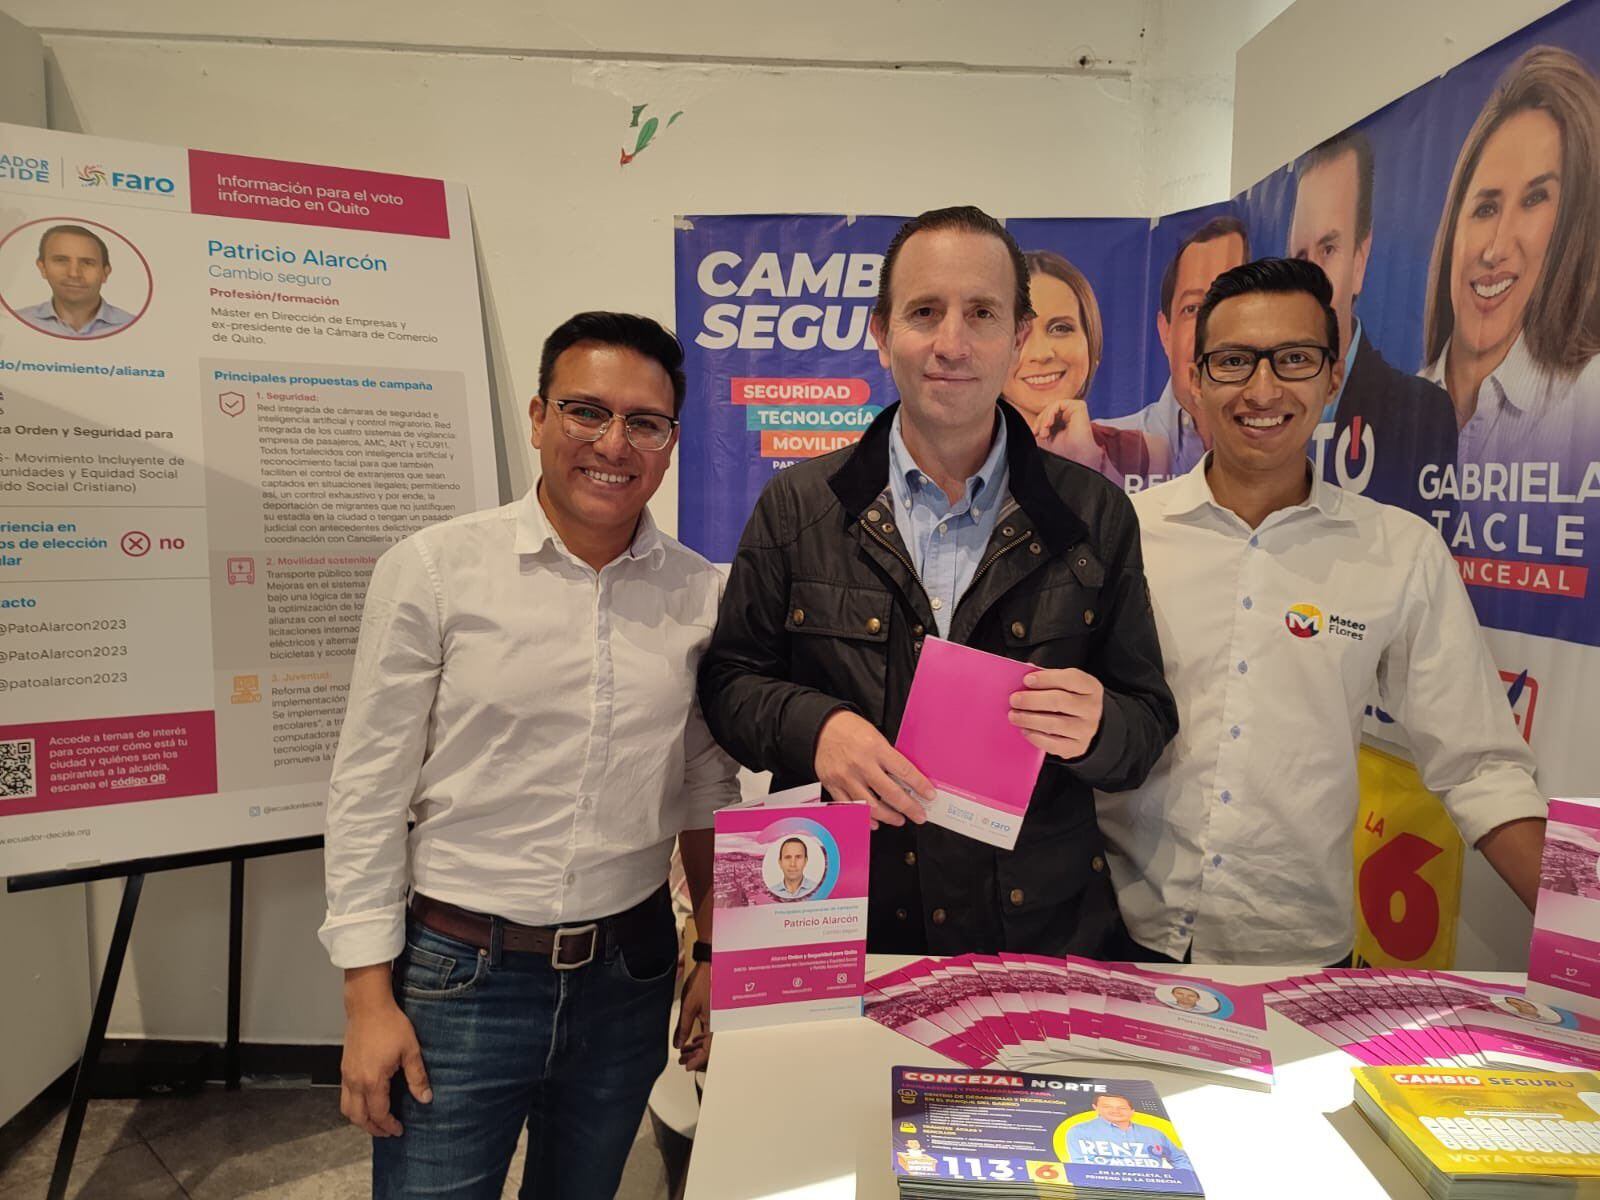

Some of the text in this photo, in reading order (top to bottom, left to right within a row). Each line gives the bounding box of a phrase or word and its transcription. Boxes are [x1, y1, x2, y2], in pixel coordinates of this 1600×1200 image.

[218, 174, 403, 205] Información para el voto
[218, 188, 369, 215] informado en Quito
[208, 241, 386, 271] Patricio Alarcón
[209, 266, 331, 287] Cambio seguro
[697, 251, 886, 298] CAMB
[210, 287, 340, 306] Profesión/formación
[211, 307, 250, 318] Máster
[271, 311, 326, 323] Dirección
[327, 314, 342, 324] de
[344, 315, 398, 327] Empresas
[400, 320, 406, 329] y
[212, 322, 438, 343] ex-presidente de la Cámara de Comercio
[212, 332, 265, 344] de Quito.
[214, 371, 432, 391] Principales propuestas de campaña
[256, 391, 318, 403] 1. Seguridad:
[744, 385, 850, 399] SEGURIDAD
[257, 404, 275, 413] Red
[277, 405, 321, 415] integrada
[322, 406, 334, 415] de
[336, 406, 373, 416] cámaras
[375, 408, 387, 417] de
[389, 410, 431, 419] seguridad
[758, 409, 874, 426] TECNOLOGÍA
[14, 425, 57, 436] Orden
[61, 429, 69, 438] y
[73, 427, 141, 439] Seguridad
[144, 431, 173, 441] para
[773, 437, 859, 450] MOVILID
[14, 454, 94, 464] Movimiento
[97, 455, 164, 467] Incluyente
[168, 456, 184, 466] de
[68, 471, 76, 480] y
[80, 469, 134, 480] Equidad
[139, 469, 178, 479] Social
[1418, 461, 1600, 503] GABRIELA
[25, 482, 68, 492] Social
[72, 483, 136, 495] Cristiano)
[263, 501, 319, 512] deportación
[320, 502, 333, 510] de
[335, 502, 378, 512] migrantes
[380, 504, 398, 512] que
[413, 502, 455, 512] justifiquen
[0, 520, 76, 533] riencia en
[18, 536, 38, 549] de
[42, 535, 107, 549] elección
[159, 537, 184, 550] no
[0, 554, 22, 566] lar
[266, 558, 273, 566] 2.
[277, 556, 325, 565] Movilidad
[267, 570, 315, 580] Transporte
[317, 569, 352, 579] público
[0, 596, 36, 608] acto
[1330, 614, 1366, 631] Mateo
[1329, 624, 1364, 640] Flores
[49, 734, 90, 745] Accede
[102, 732, 134, 742] temas
[136, 729, 150, 739] de
[152, 726, 187, 738] interés
[49, 737, 188, 759] para conocer cómo está tu
[50, 750, 178, 769] ciudad y quiénes son los
[50, 769, 104, 782] aspirantes
[116, 766, 126, 775] la
[128, 761, 170, 774] alcaldía,
[51, 782, 96, 793] escanea
[98, 779, 108, 789] el
[110, 777, 146, 788] código
[1365, 811, 1385, 838] LA
[1359, 832, 1444, 962] 6
[784, 914, 858, 928] Patricio Alarcón
[904, 1072, 1022, 1087] CONCEJAL
[1031, 1078, 1107, 1093] NORTE
[1393, 1074, 1574, 1088] CAMBIO SEGURO
[1448, 1152, 1507, 1163] VOTA
[1514, 1154, 1576, 1166] TODO
[942, 1156, 1014, 1179] 113
[1036, 1164, 1059, 1180] 6
